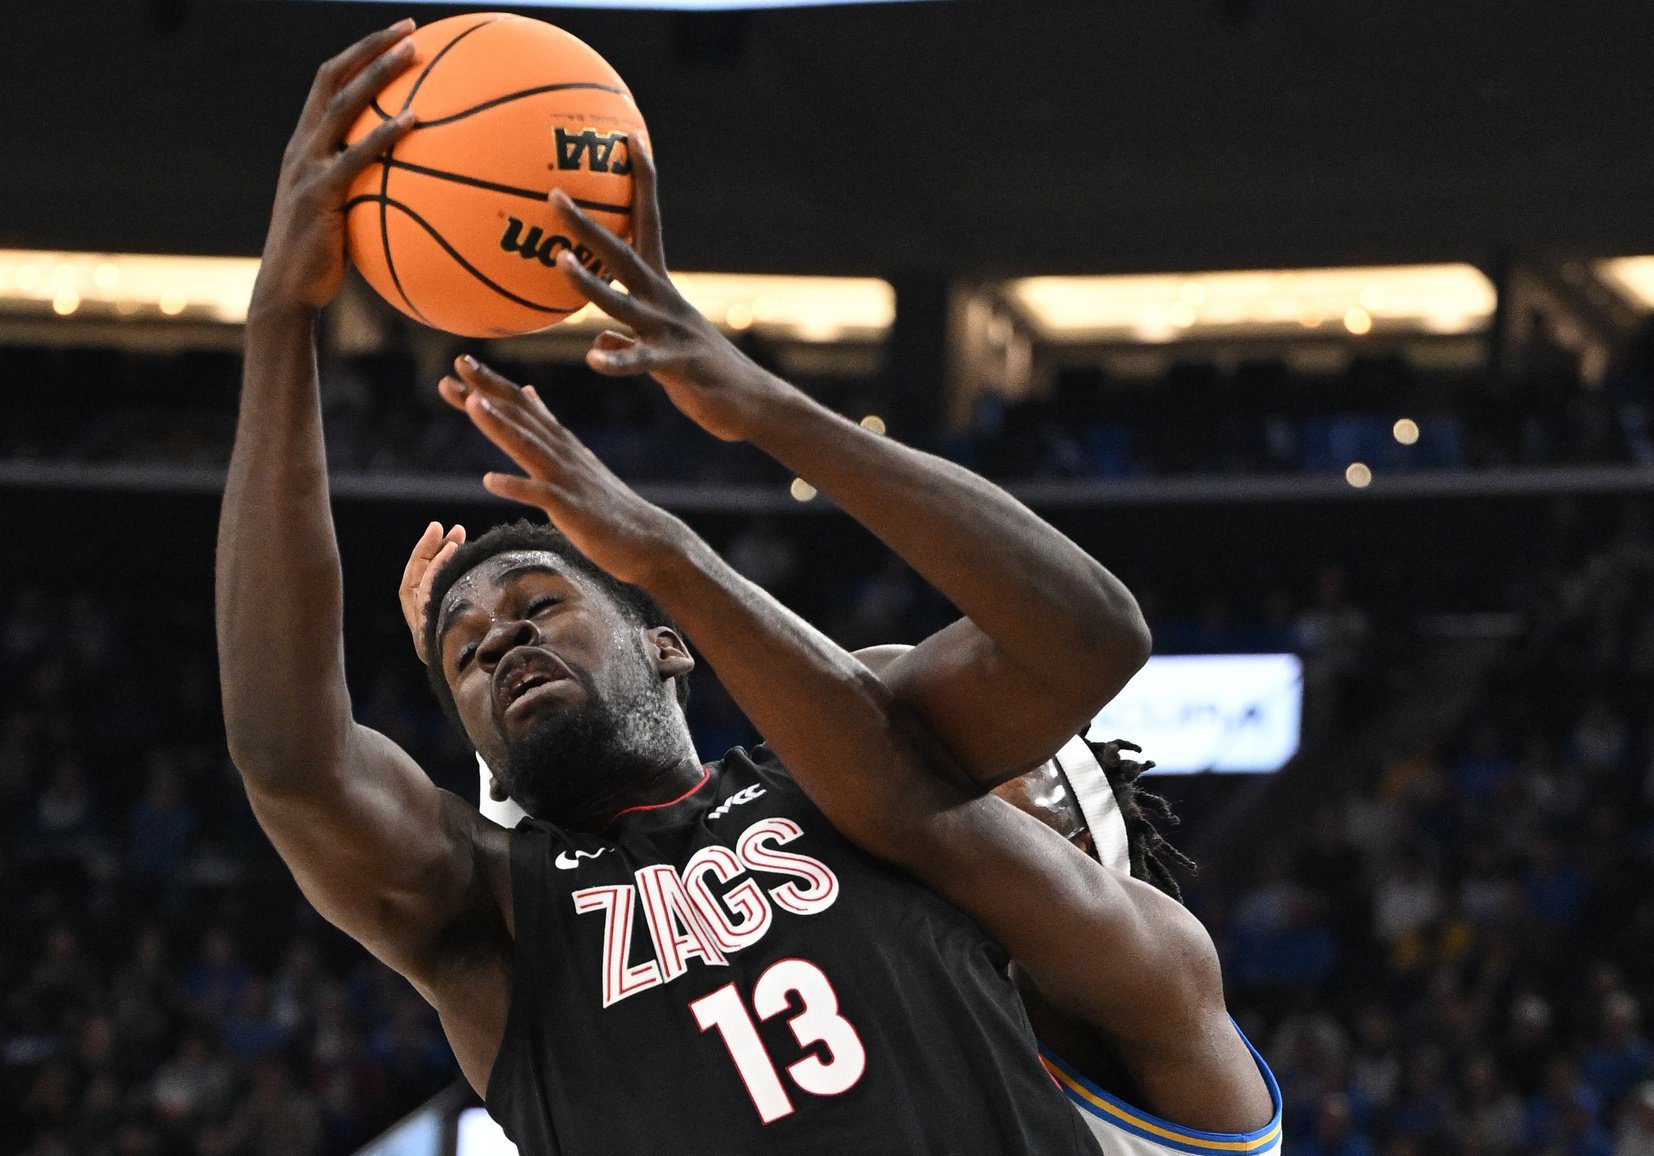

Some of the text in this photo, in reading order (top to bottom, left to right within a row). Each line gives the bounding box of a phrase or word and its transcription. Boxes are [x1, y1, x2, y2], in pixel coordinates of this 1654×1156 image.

[708, 783, 767, 820] WCC
[572, 817, 839, 1008] ZAGS
[688, 957, 867, 1126] 13
